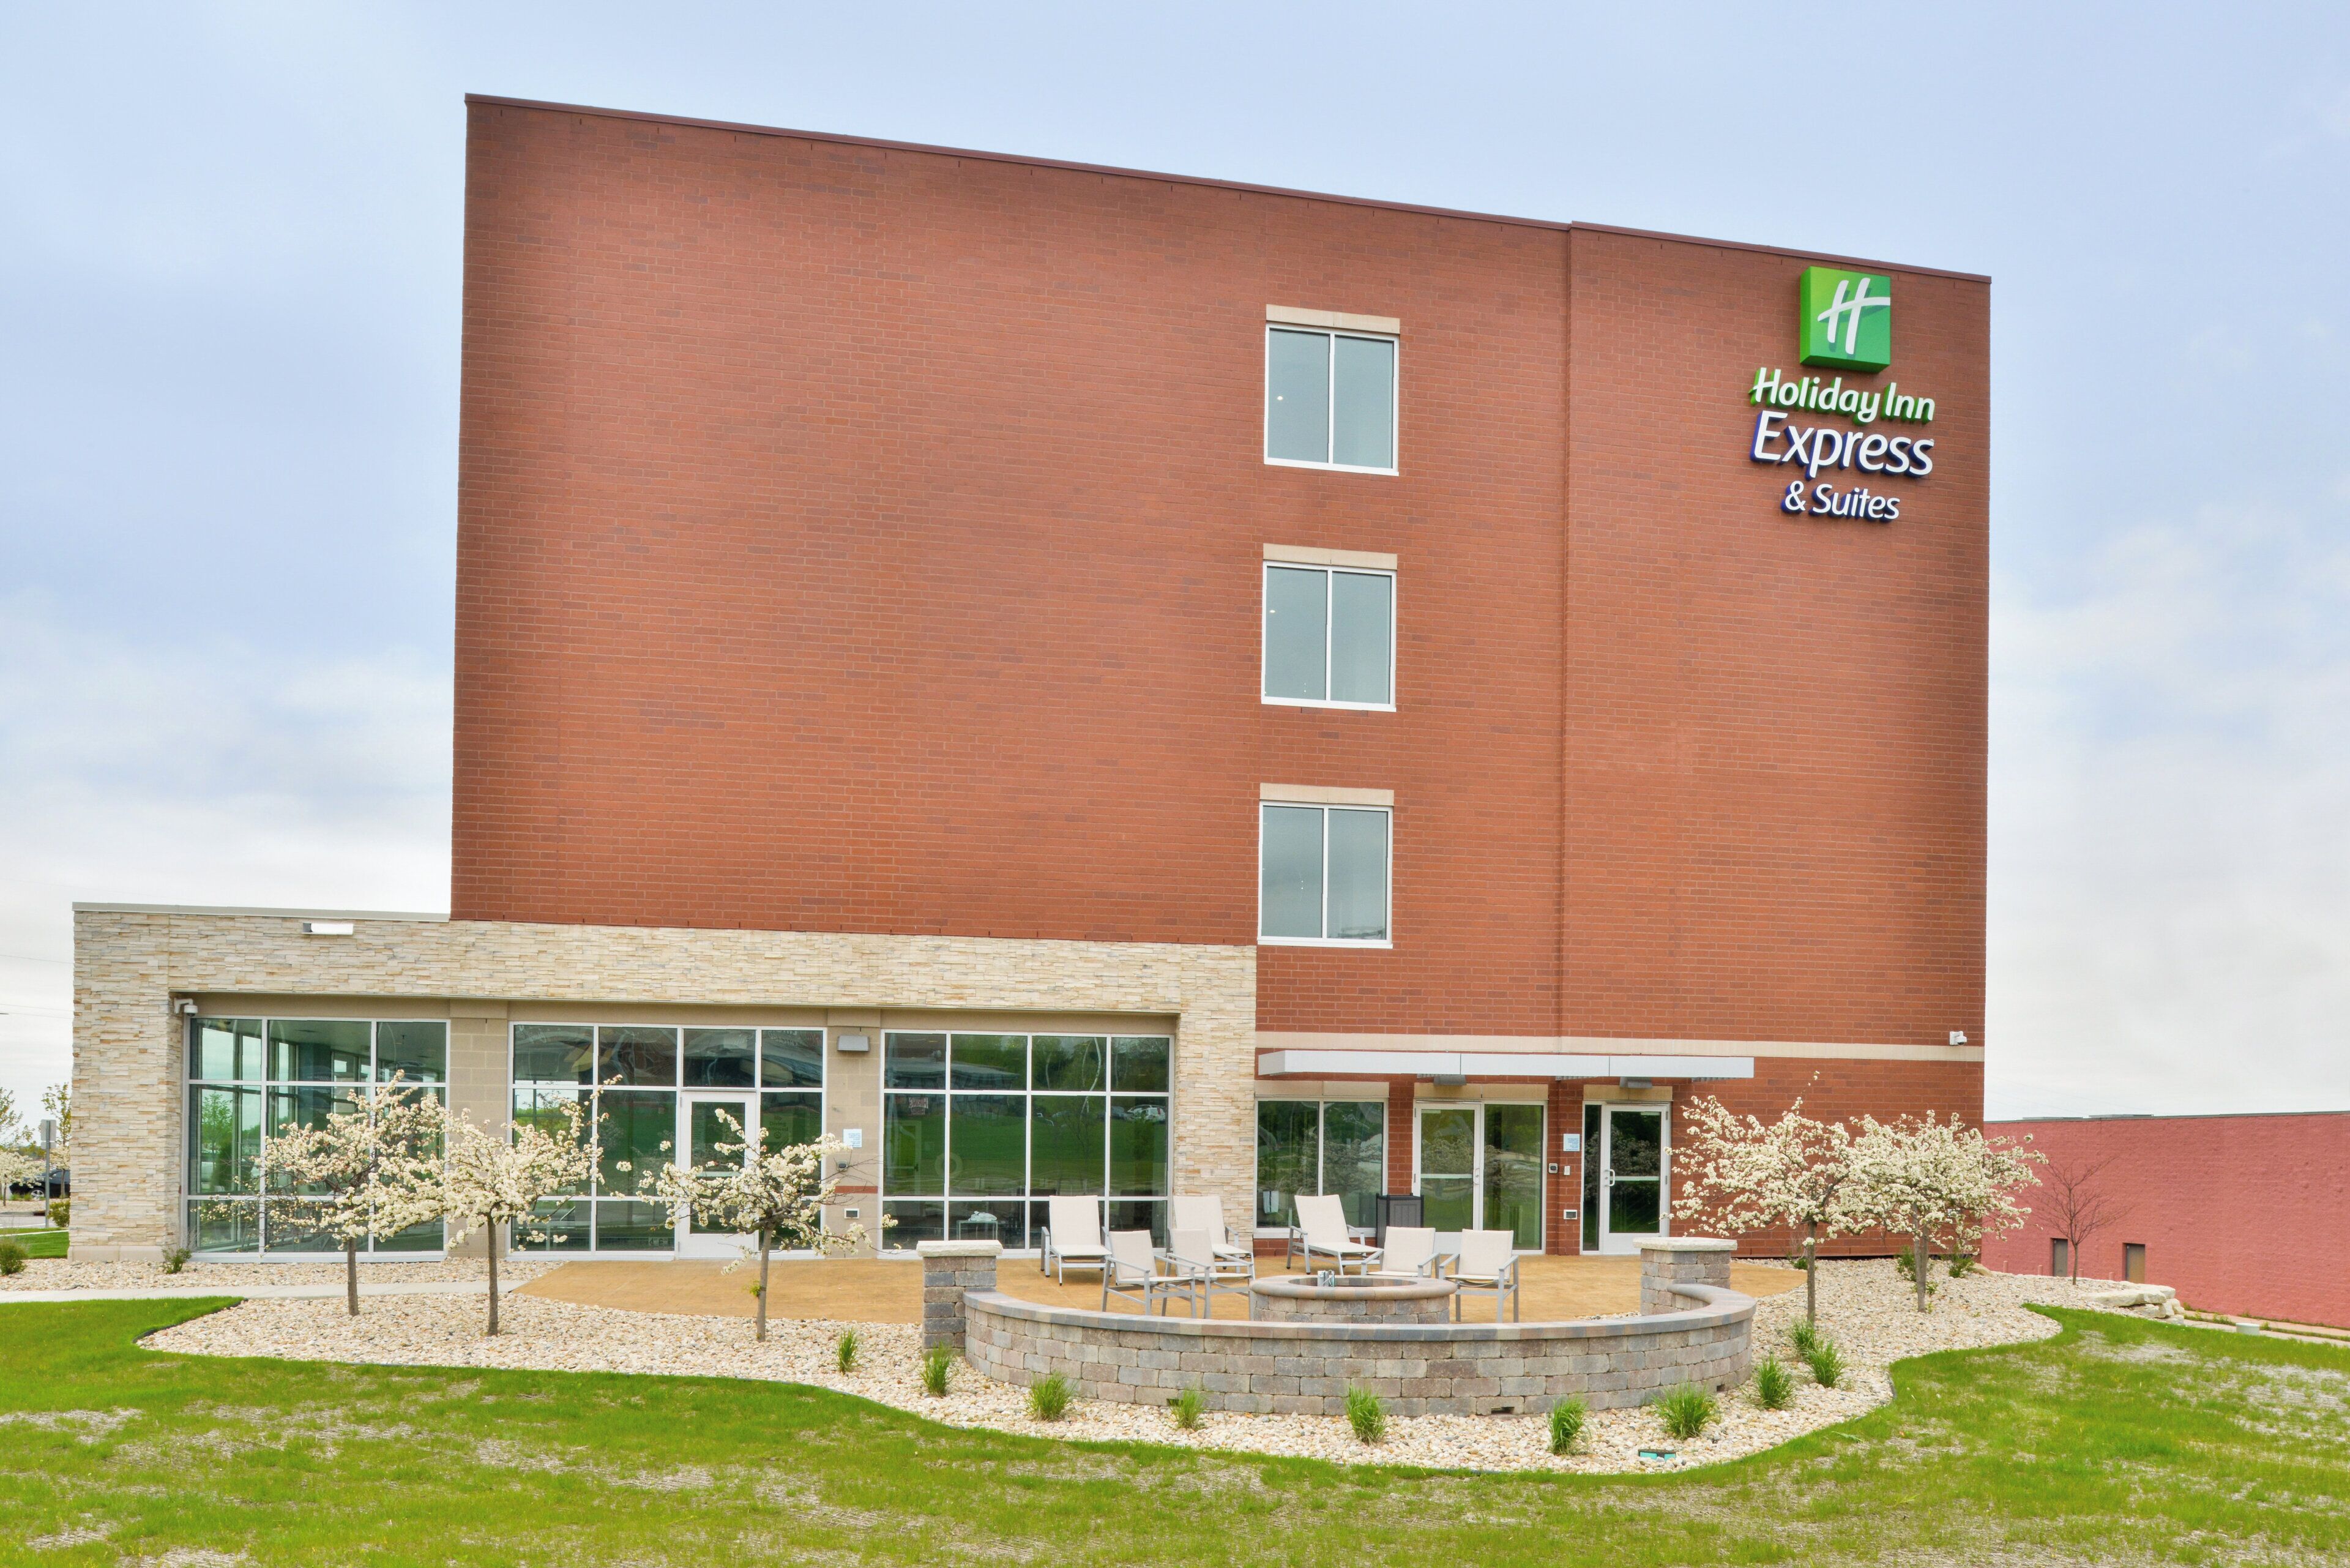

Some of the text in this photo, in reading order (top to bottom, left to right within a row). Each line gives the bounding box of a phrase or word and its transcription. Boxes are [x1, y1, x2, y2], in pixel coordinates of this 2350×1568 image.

[1817, 277, 1890, 354] H
[1750, 367, 1935, 424] Holiday Inn
[1751, 410, 1934, 479] Express
[1783, 480, 1900, 520] & Suites
